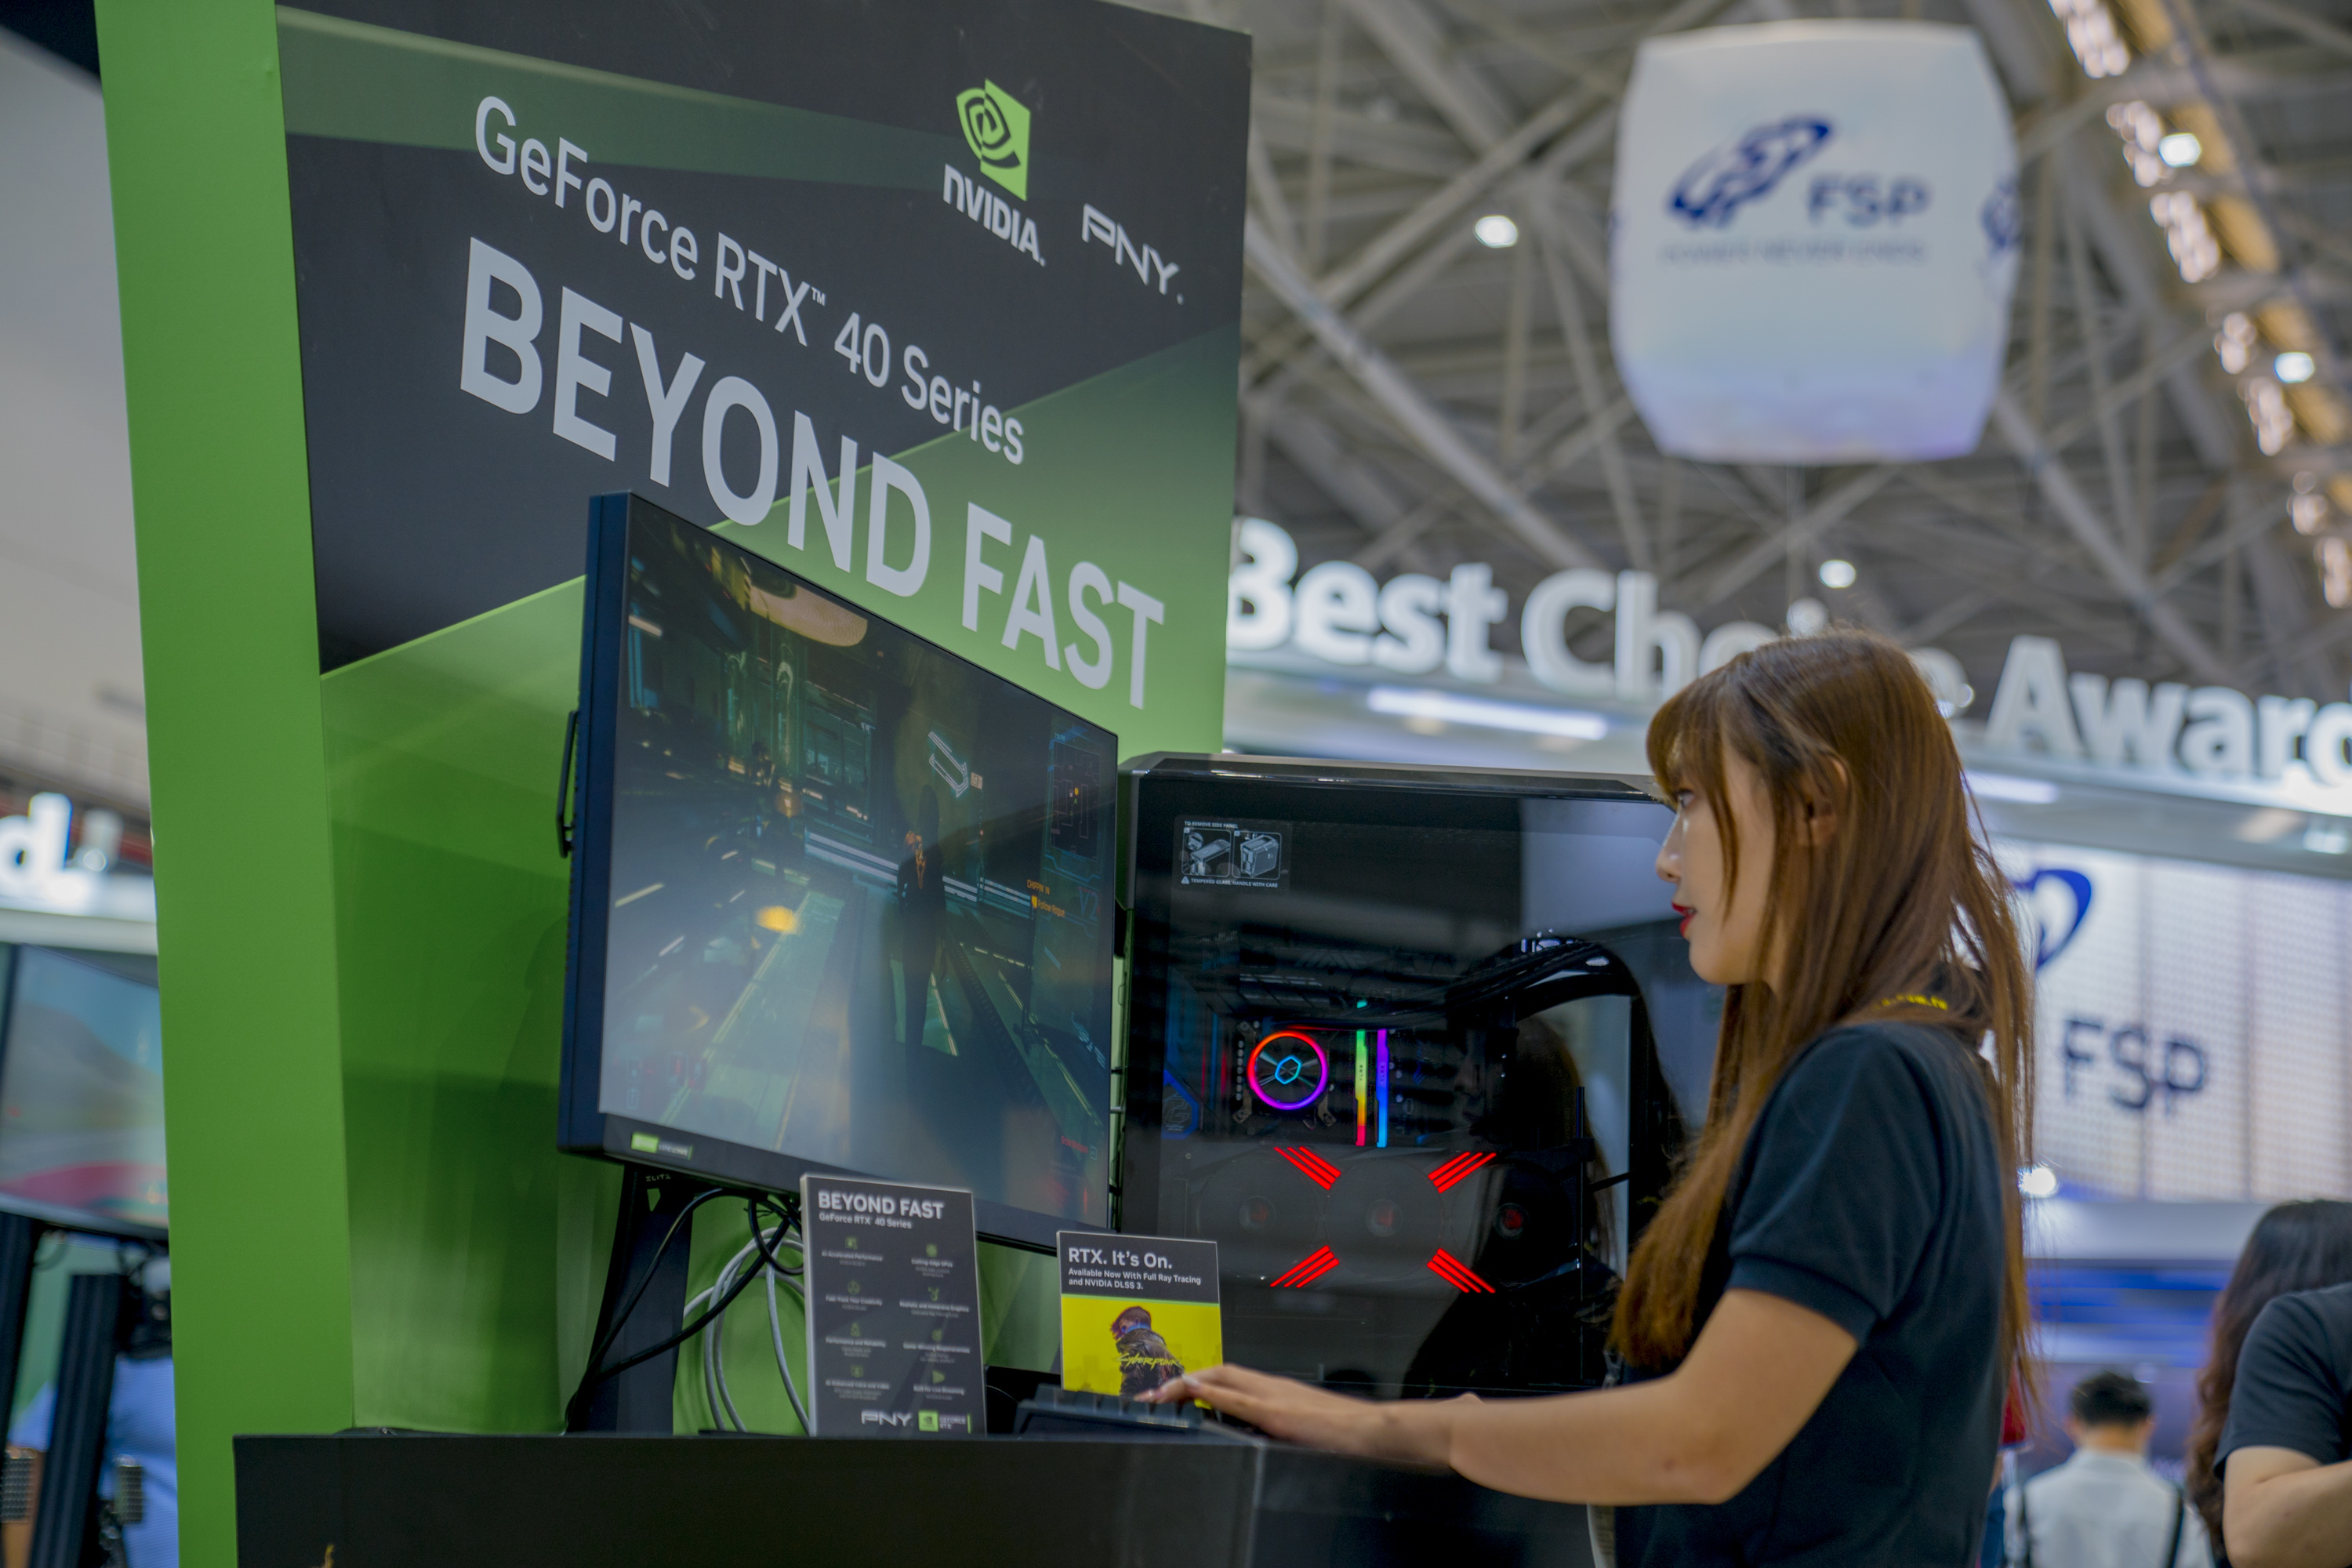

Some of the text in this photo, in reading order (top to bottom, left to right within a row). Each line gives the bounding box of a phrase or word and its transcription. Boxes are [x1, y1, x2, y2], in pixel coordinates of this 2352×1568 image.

[943, 163, 1041, 263] NVIDIA
[1806, 174, 1933, 227] FSP
[1082, 203, 1179, 296] PNY
[475, 96, 698, 281] GeForce
[834, 311, 891, 388] 40
[902, 344, 1024, 465] Series
[460, 237, 1165, 710] BEYOND FAST
[1226, 516, 1508, 684] Best
[2062, 1014, 2209, 1119] FSP
[818, 1190, 945, 1220] BEYOND FAST
[818, 1212, 852, 1224] GeForce
[874, 1218, 886, 1227] 40
[887, 1219, 912, 1229] Series
[1068, 1247, 1108, 1265] RTX.
[1144, 1253, 1173, 1269] On.
[1068, 1268, 1102, 1278] Available
[1104, 1270, 1121, 1279] Now
[1122, 1271, 1142, 1280] With
[1158, 1274, 1172, 1283] Ray
[1173, 1275, 1201, 1286] Tracing
[1084, 1279, 1112, 1288] NVIDIA
[1114, 1281, 1134, 1290] DLSS
[1136, 1282, 1144, 1290] 3.
[861, 1410, 912, 1427] PNY
